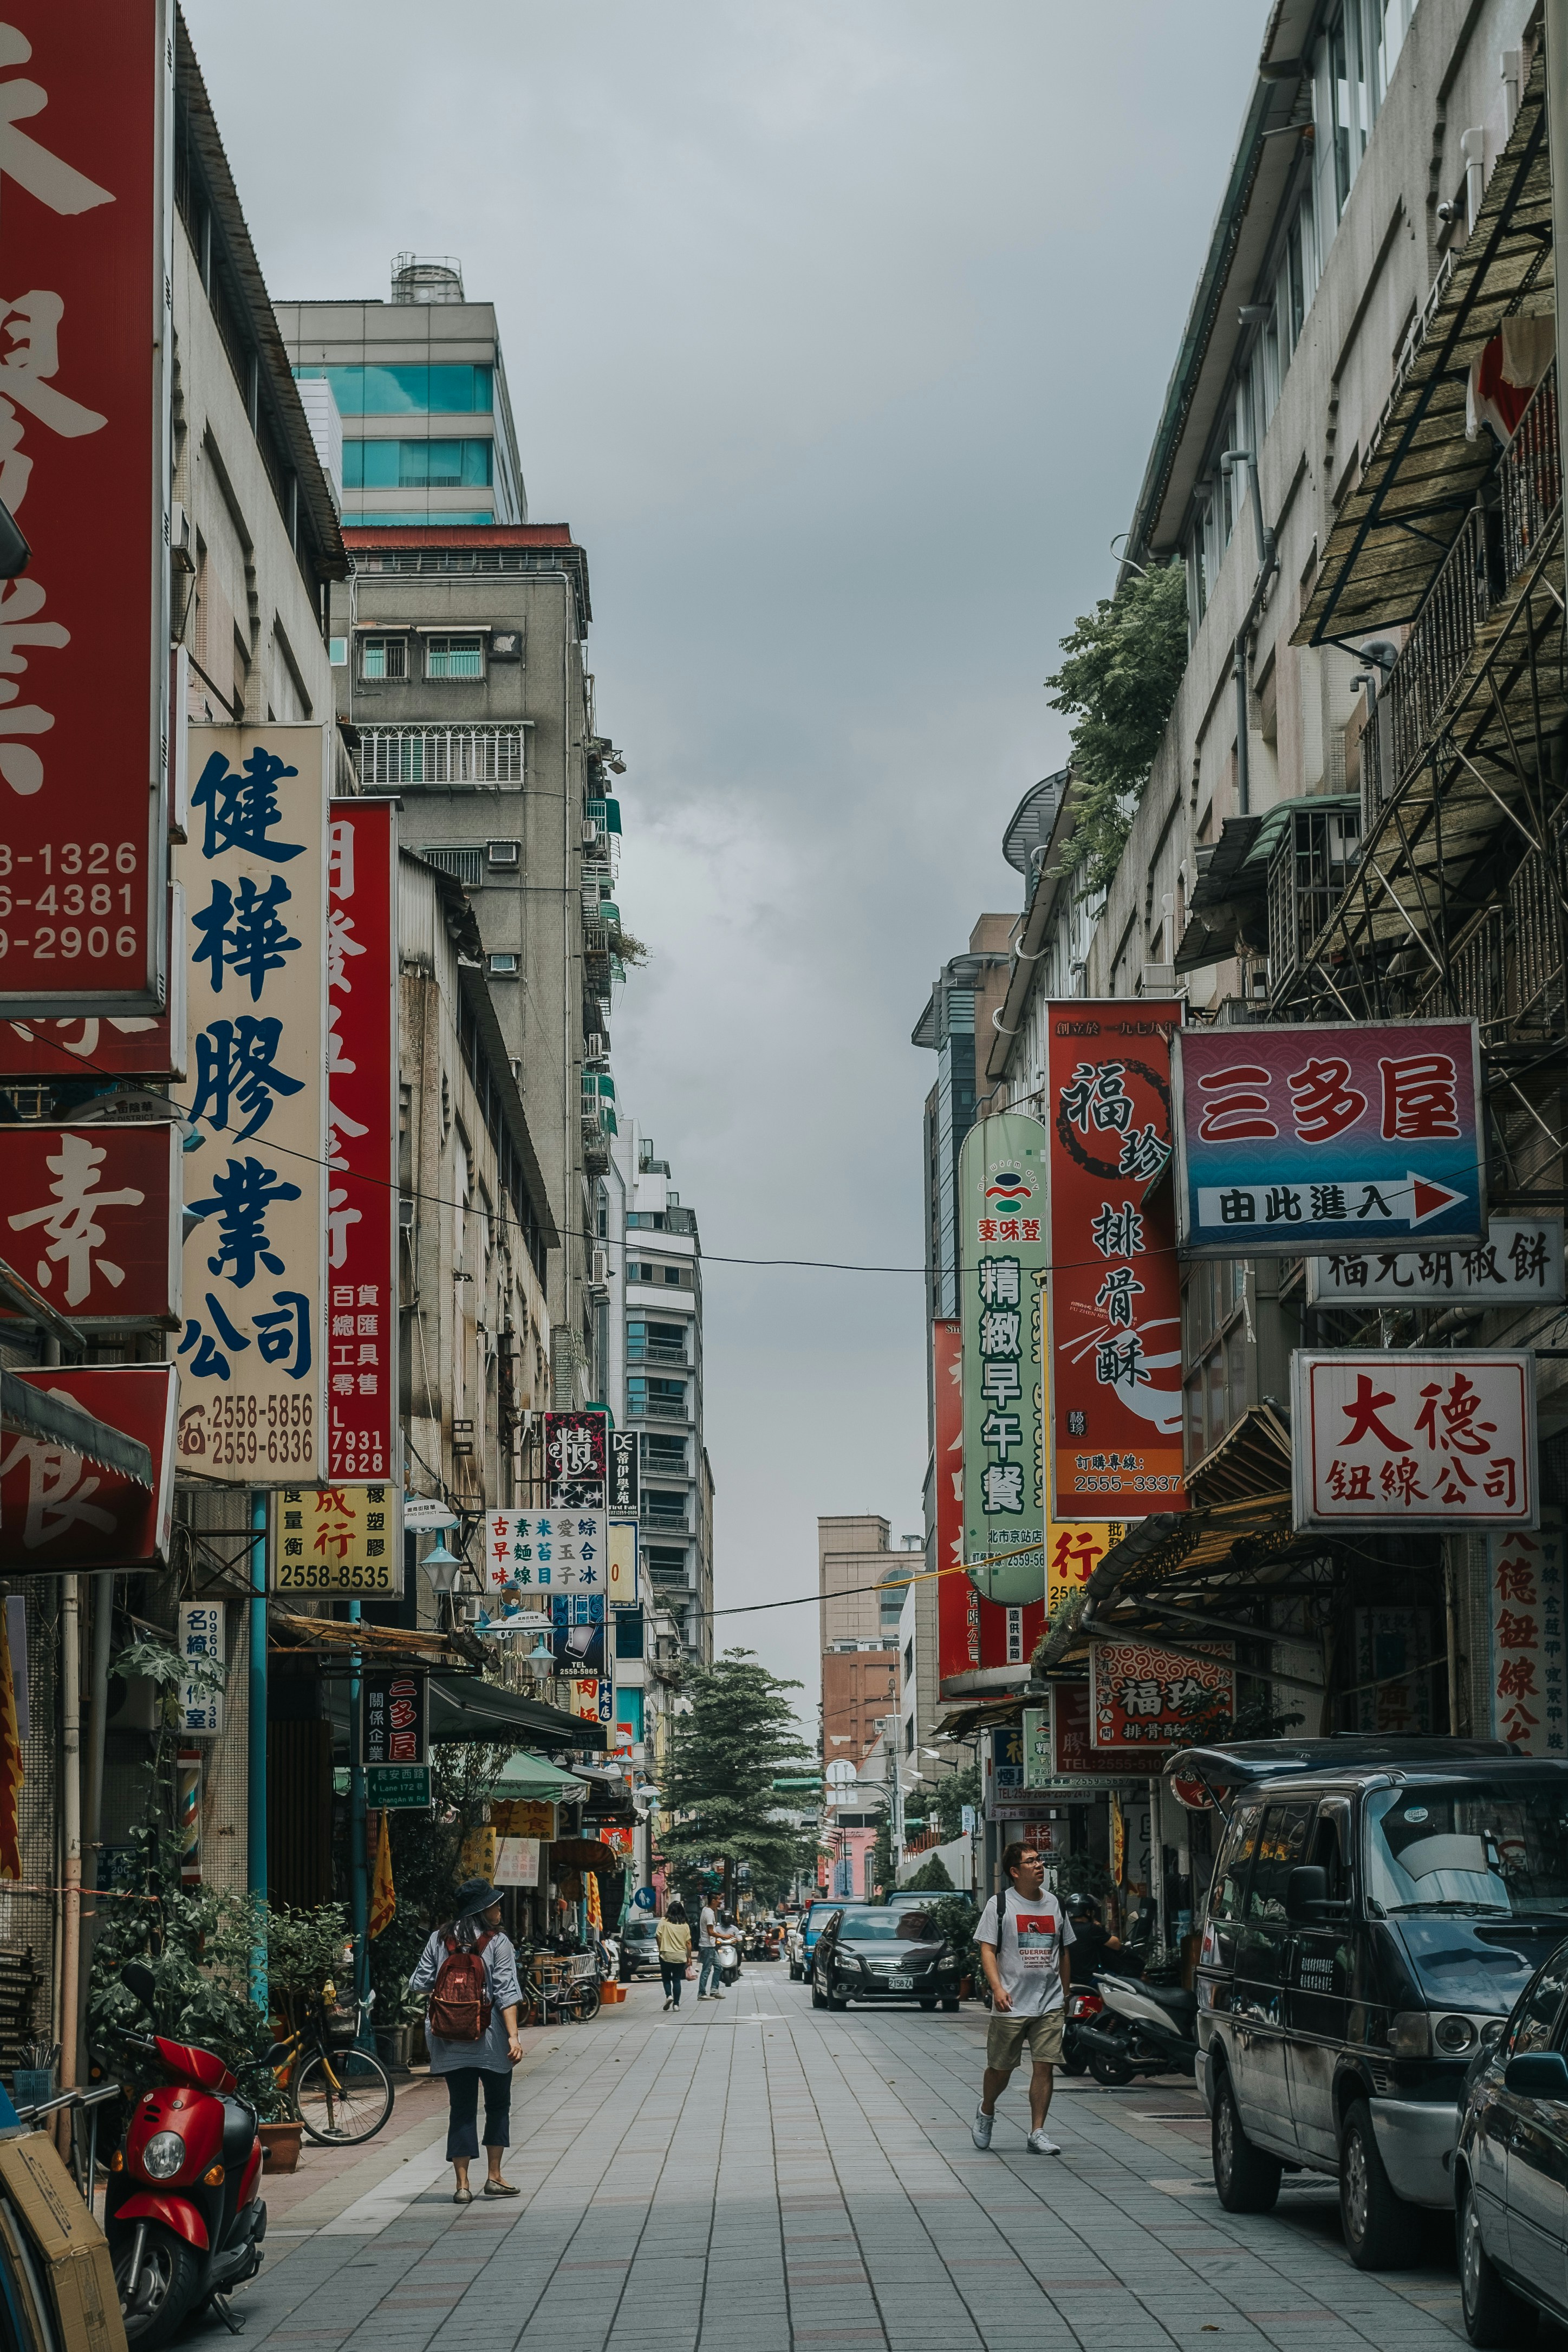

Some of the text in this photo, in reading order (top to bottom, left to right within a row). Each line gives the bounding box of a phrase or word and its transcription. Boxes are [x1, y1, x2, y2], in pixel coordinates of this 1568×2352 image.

[1057, 1023, 1099, 1035] 創立於
[1198, 1054, 1462, 1145] 三多屋
[8, 1133, 145, 1307] 素
[979, 1219, 1040, 1241] 麥味登
[1220, 1185, 1392, 1224] 由此進入
[212, 1393, 313, 1428] 2558-5856
[980, 1259, 1024, 1511] 精緻早午餐
[1337, 1373, 1498, 1456] 大德
[212, 1429, 313, 1464] 2559-6336
[549, 1427, 597, 1481] 精
[616, 1452, 630, 1504] 蒂伊學苑
[1075, 1476, 1181, 1492] 2555-3337
[1325, 1456, 1517, 1508] 鈕線公司
[280, 1565, 389, 1589] 2558-8535
[491, 1516, 510, 1586] 古早味
[513, 1518, 533, 1585] 素麵線
[535, 1518, 554, 1585] 米苔目
[557, 1518, 576, 1585] 愛玉子
[577, 1518, 598, 1585] 綜合冰
[1052, 1531, 1103, 1582] 行
[369, 1693, 383, 1760] 關係企業
[389, 1680, 417, 1760] 三多屋
[378, 1769, 425, 1781] 長安西路
